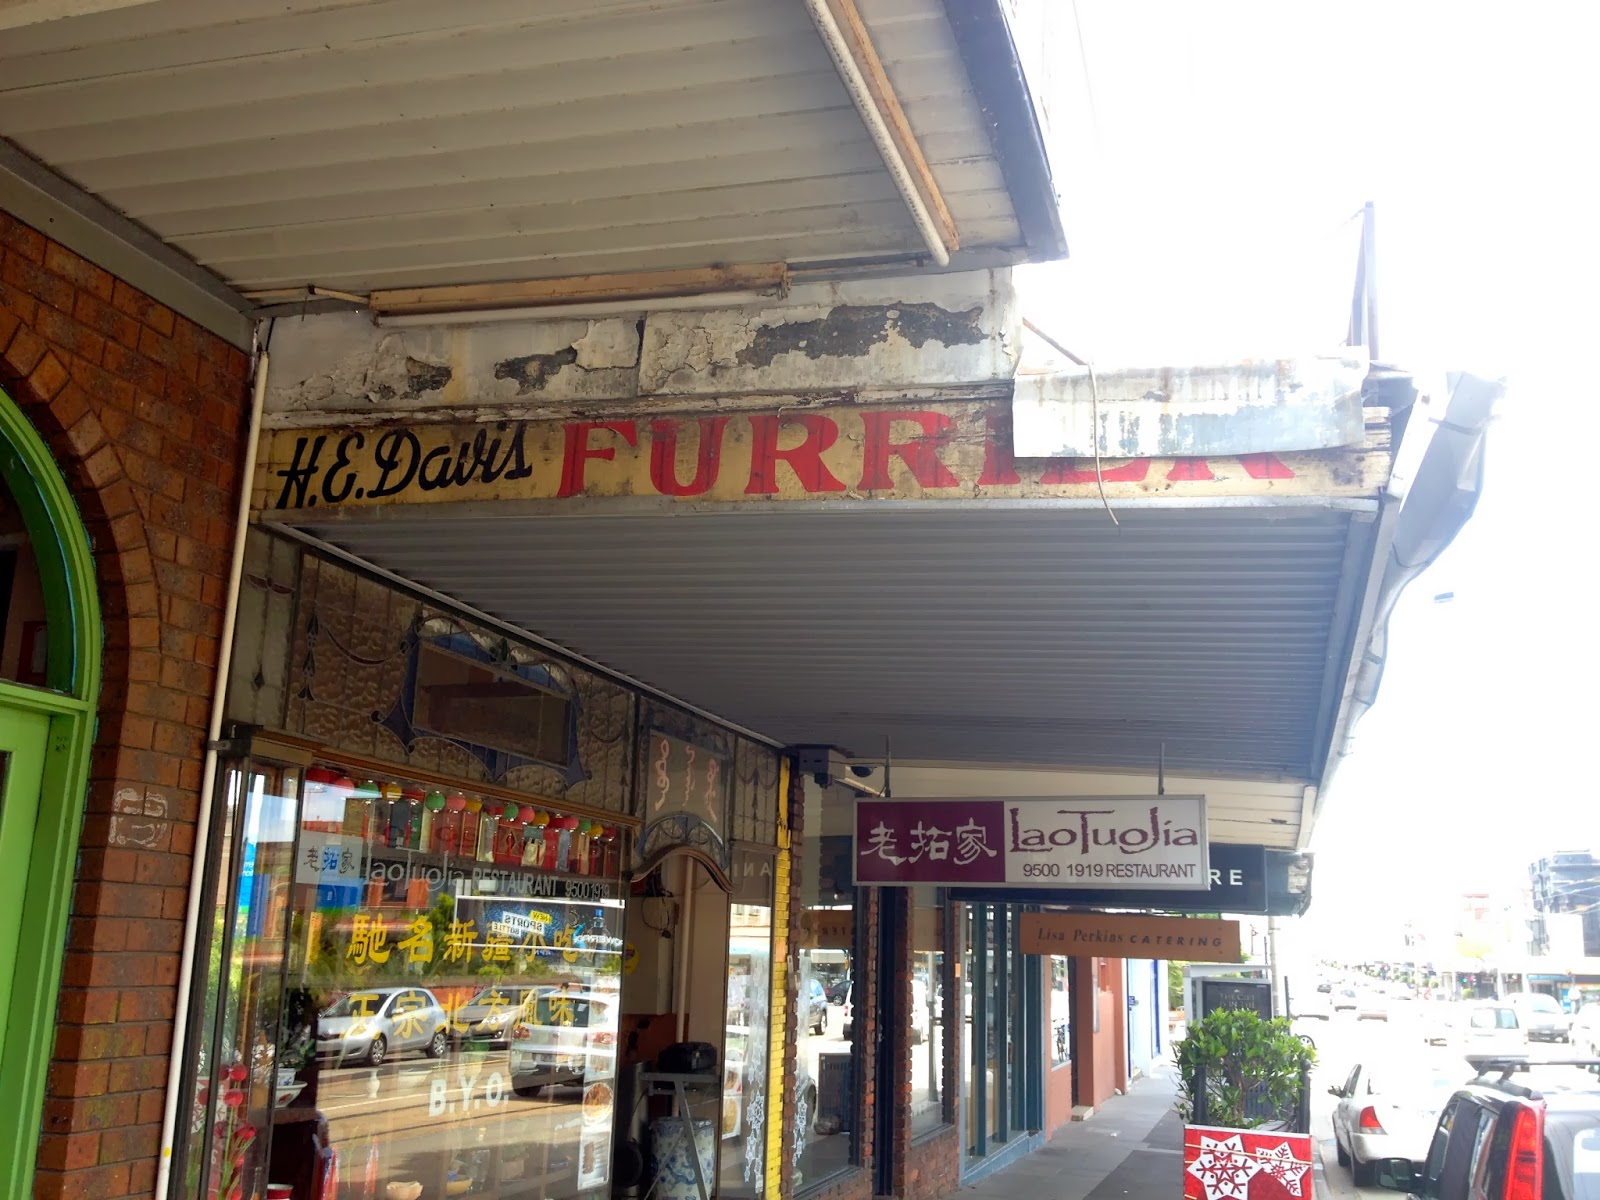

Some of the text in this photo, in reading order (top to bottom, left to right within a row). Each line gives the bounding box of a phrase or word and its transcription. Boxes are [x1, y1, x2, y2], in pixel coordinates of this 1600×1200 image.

[557, 408, 1296, 499] FURRI
[860, 816, 998, 866] 老拓家
[472, 867, 559, 897] RESTAURANT
[1023, 863, 1196, 878] 9500 1919 RESTAURANT
[1038, 928, 1223, 947] Lisa Perkins CATERING
